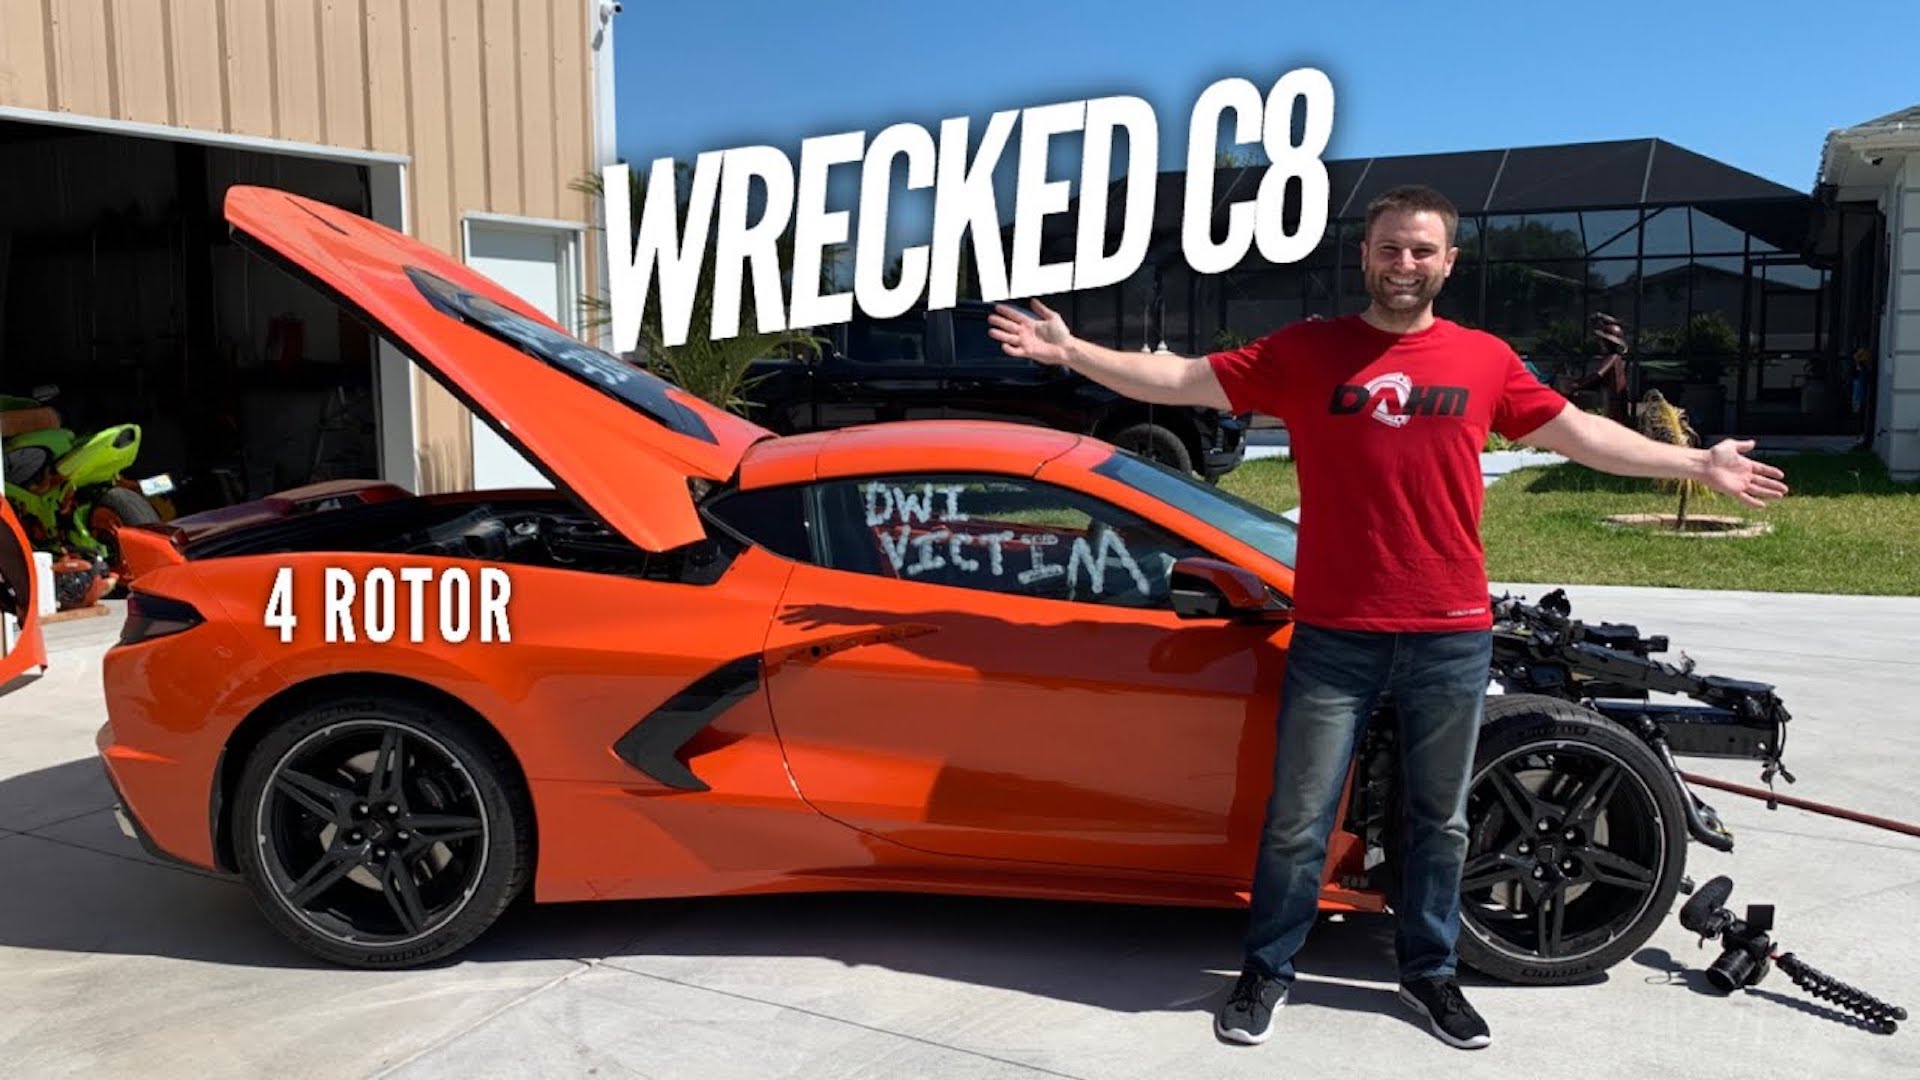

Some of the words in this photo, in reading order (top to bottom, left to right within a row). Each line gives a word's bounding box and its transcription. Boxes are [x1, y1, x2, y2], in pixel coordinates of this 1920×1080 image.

[1328, 384, 1469, 416] DAHM
[866, 481, 969, 527] DWI
[880, 525, 1150, 596] VICTIM
